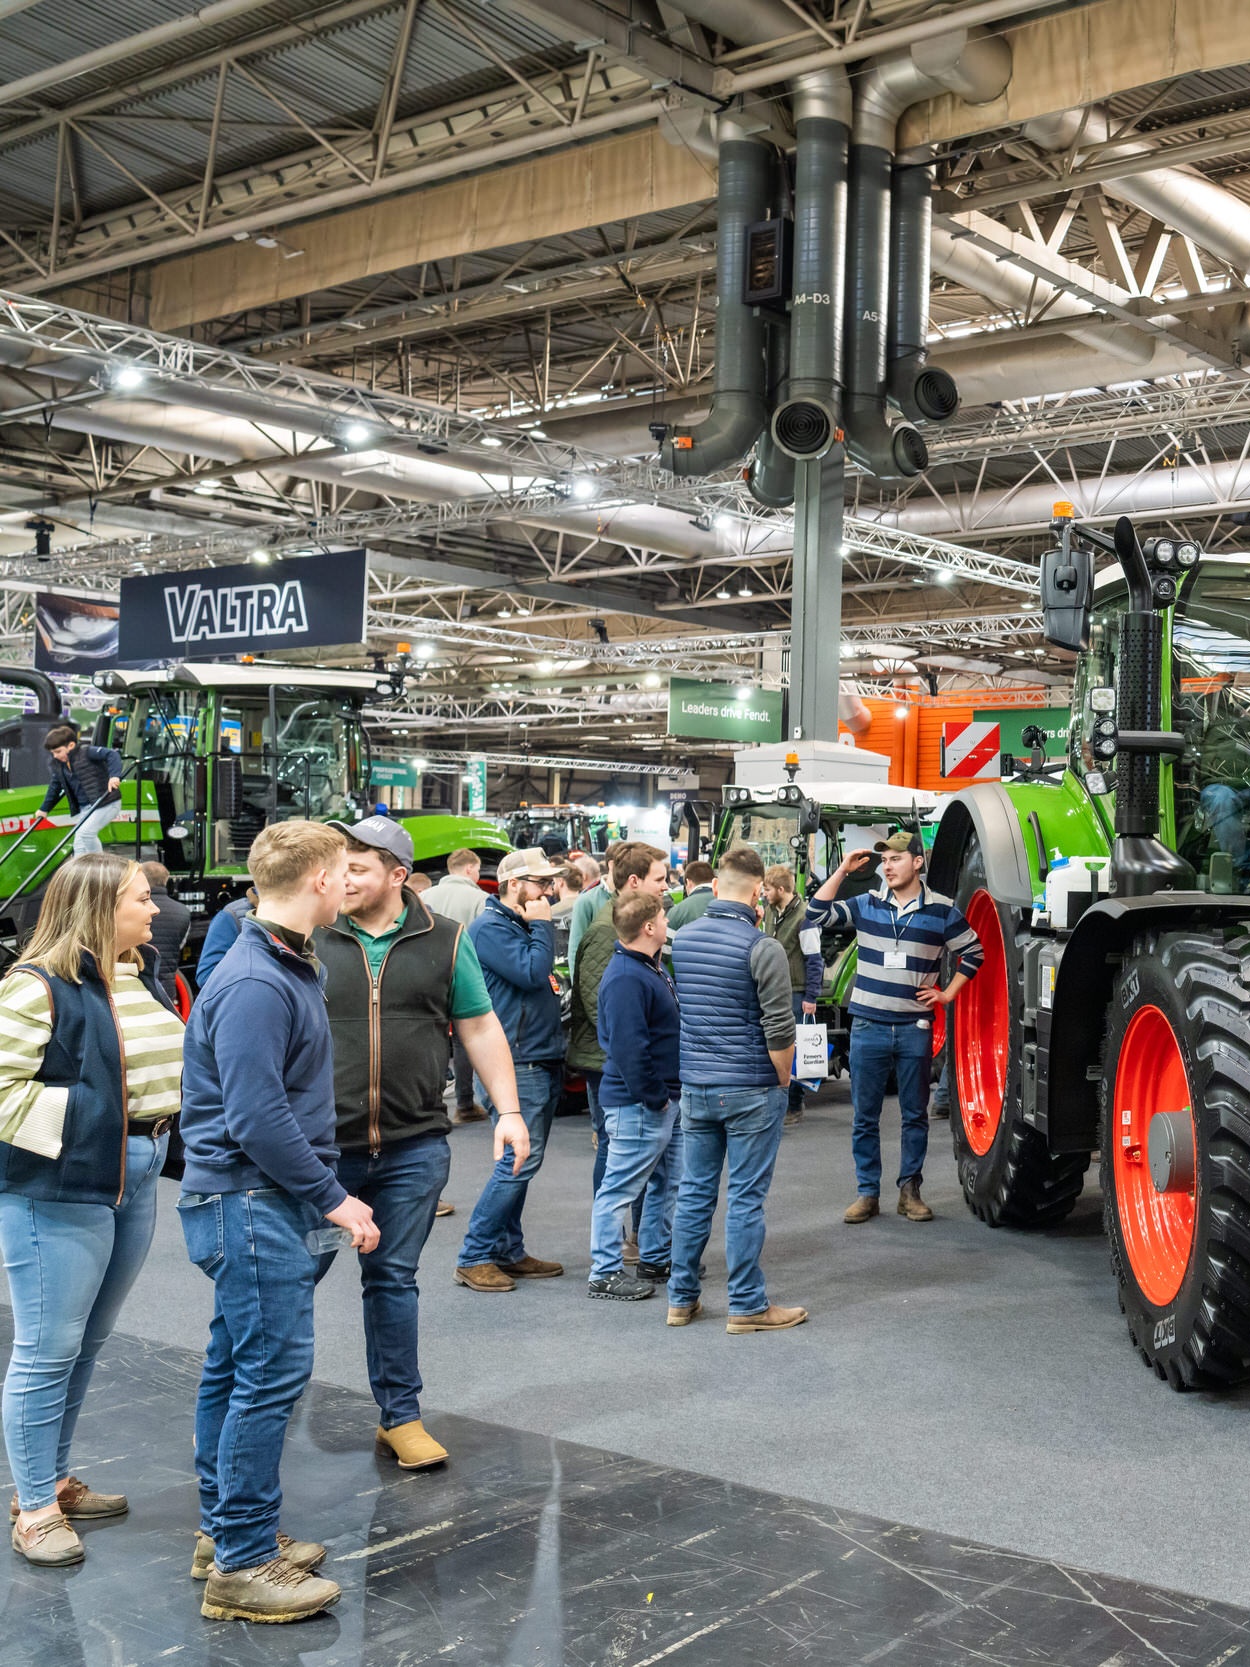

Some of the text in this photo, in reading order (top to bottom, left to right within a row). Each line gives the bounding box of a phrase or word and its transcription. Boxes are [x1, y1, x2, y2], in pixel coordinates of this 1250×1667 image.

[794, 293, 830, 305] A4-D3
[164, 580, 309, 643] VALTRA
[681, 701, 771, 722] Leaders drive Fendt.
[1121, 968, 1139, 1009] BKT
[1153, 1313, 1176, 1350] BKT
